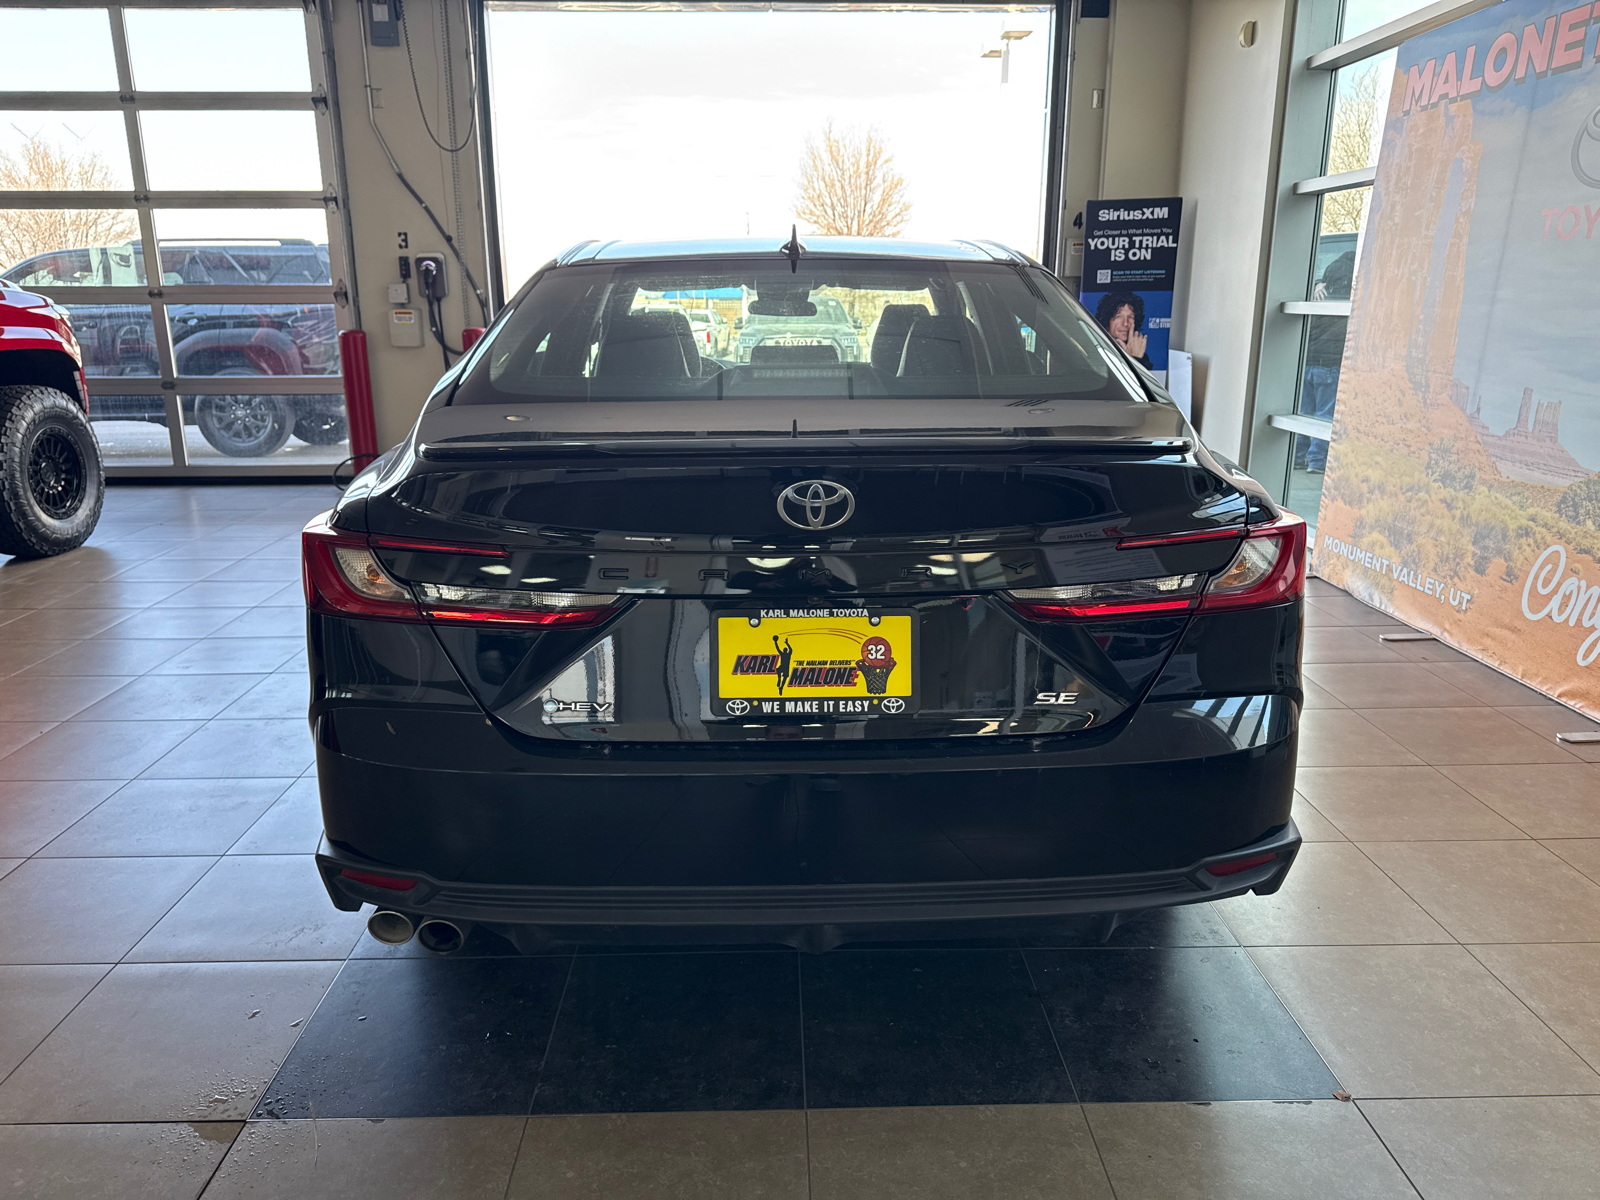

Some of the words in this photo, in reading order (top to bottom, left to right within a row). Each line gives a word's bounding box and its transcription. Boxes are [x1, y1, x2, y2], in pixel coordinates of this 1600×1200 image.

[1073, 211, 1083, 230] 4
[1098, 207, 1169, 221] SiriusXM
[397, 232, 409, 249] 3
[1088, 236, 1129, 250] YOUR
[1133, 235, 1177, 248] TRIAL
[1110, 249, 1125, 261] IS
[1128, 248, 1152, 261] ON
[598, 562, 1036, 581] CAMRY
[1324, 534, 1390, 575] MONUMENT
[1392, 562, 1445, 604] VALLEY,
[1449, 587, 1472, 611] UT
[760, 609, 787, 618] KARL
[789, 609, 830, 618] MALONE
[832, 608, 869, 617] TOYOTA
[867, 644, 886, 660] 32
[731, 654, 780, 675] KARL
[787, 667, 860, 688] MALONE
[1033, 692, 1079, 705] SE
[559, 702, 611, 712] HEV
[762, 701, 780, 713] WE
[785, 701, 819, 713] MAKE
[824, 701, 835, 712] IT
[839, 701, 870, 712] EASY
